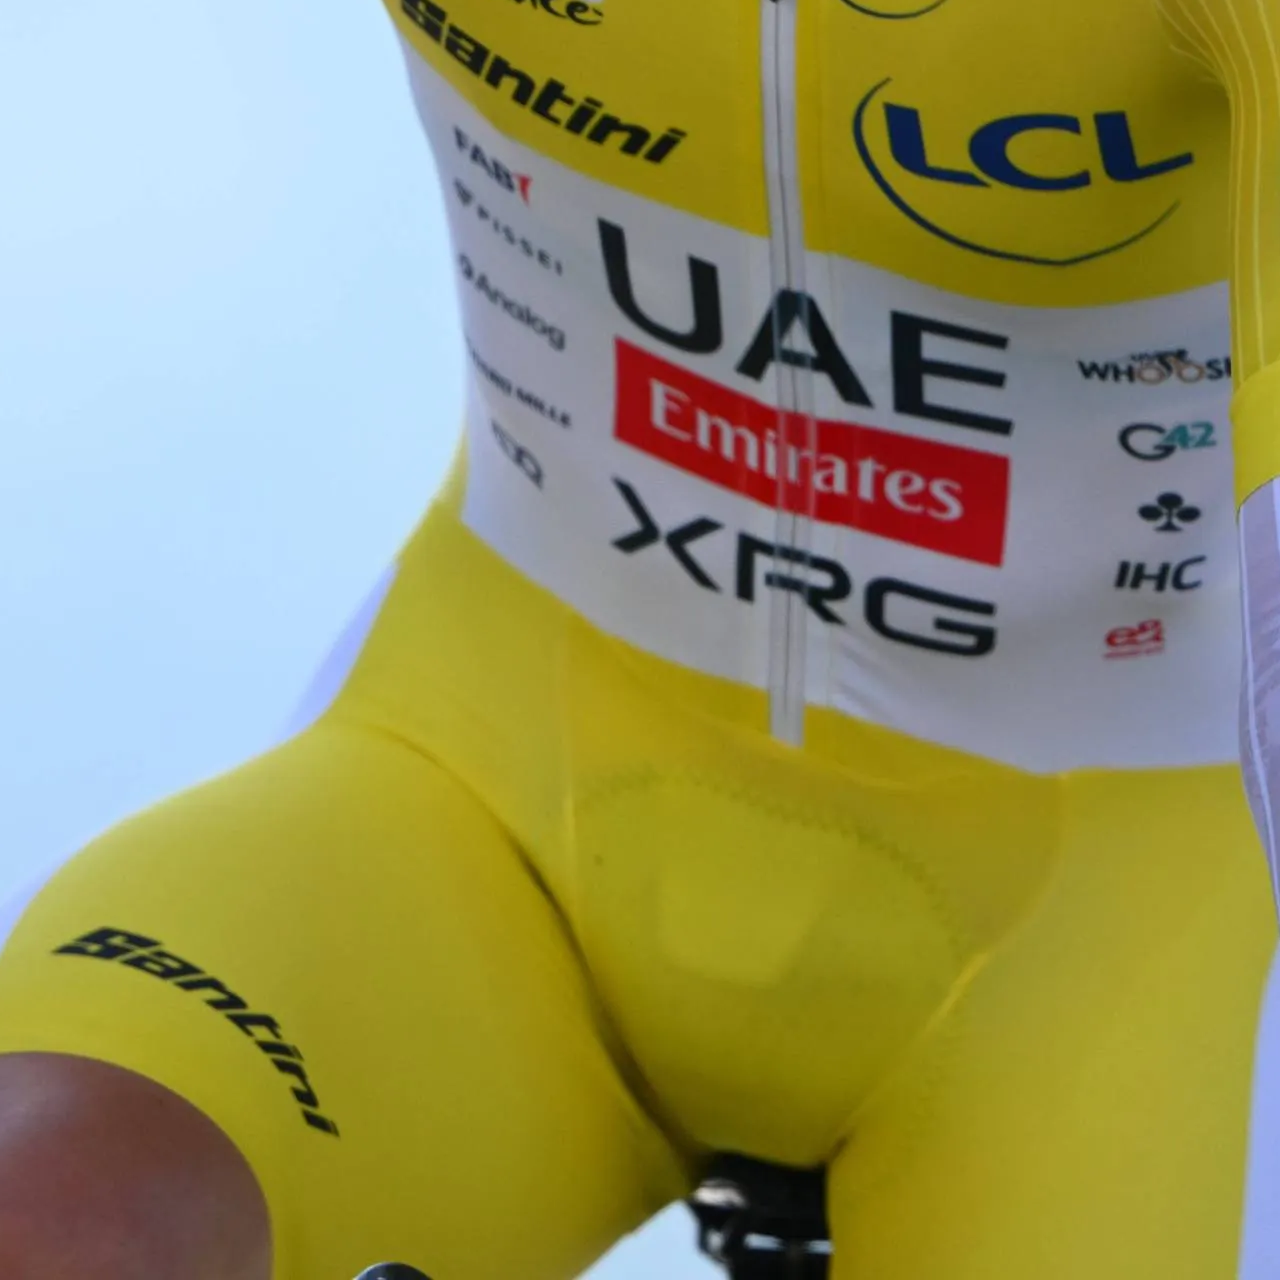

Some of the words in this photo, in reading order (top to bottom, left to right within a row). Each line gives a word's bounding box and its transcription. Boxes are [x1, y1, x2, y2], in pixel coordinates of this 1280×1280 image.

[882, 101, 1194, 194] LCL
[598, 218, 1014, 437] UAE
[648, 376, 965, 523] Emirates
[1118, 421, 1218, 461] G42
[612, 477, 999, 659] XRG
[1113, 555, 1208, 593] IHC
[51, 927, 341, 1139] Santini
